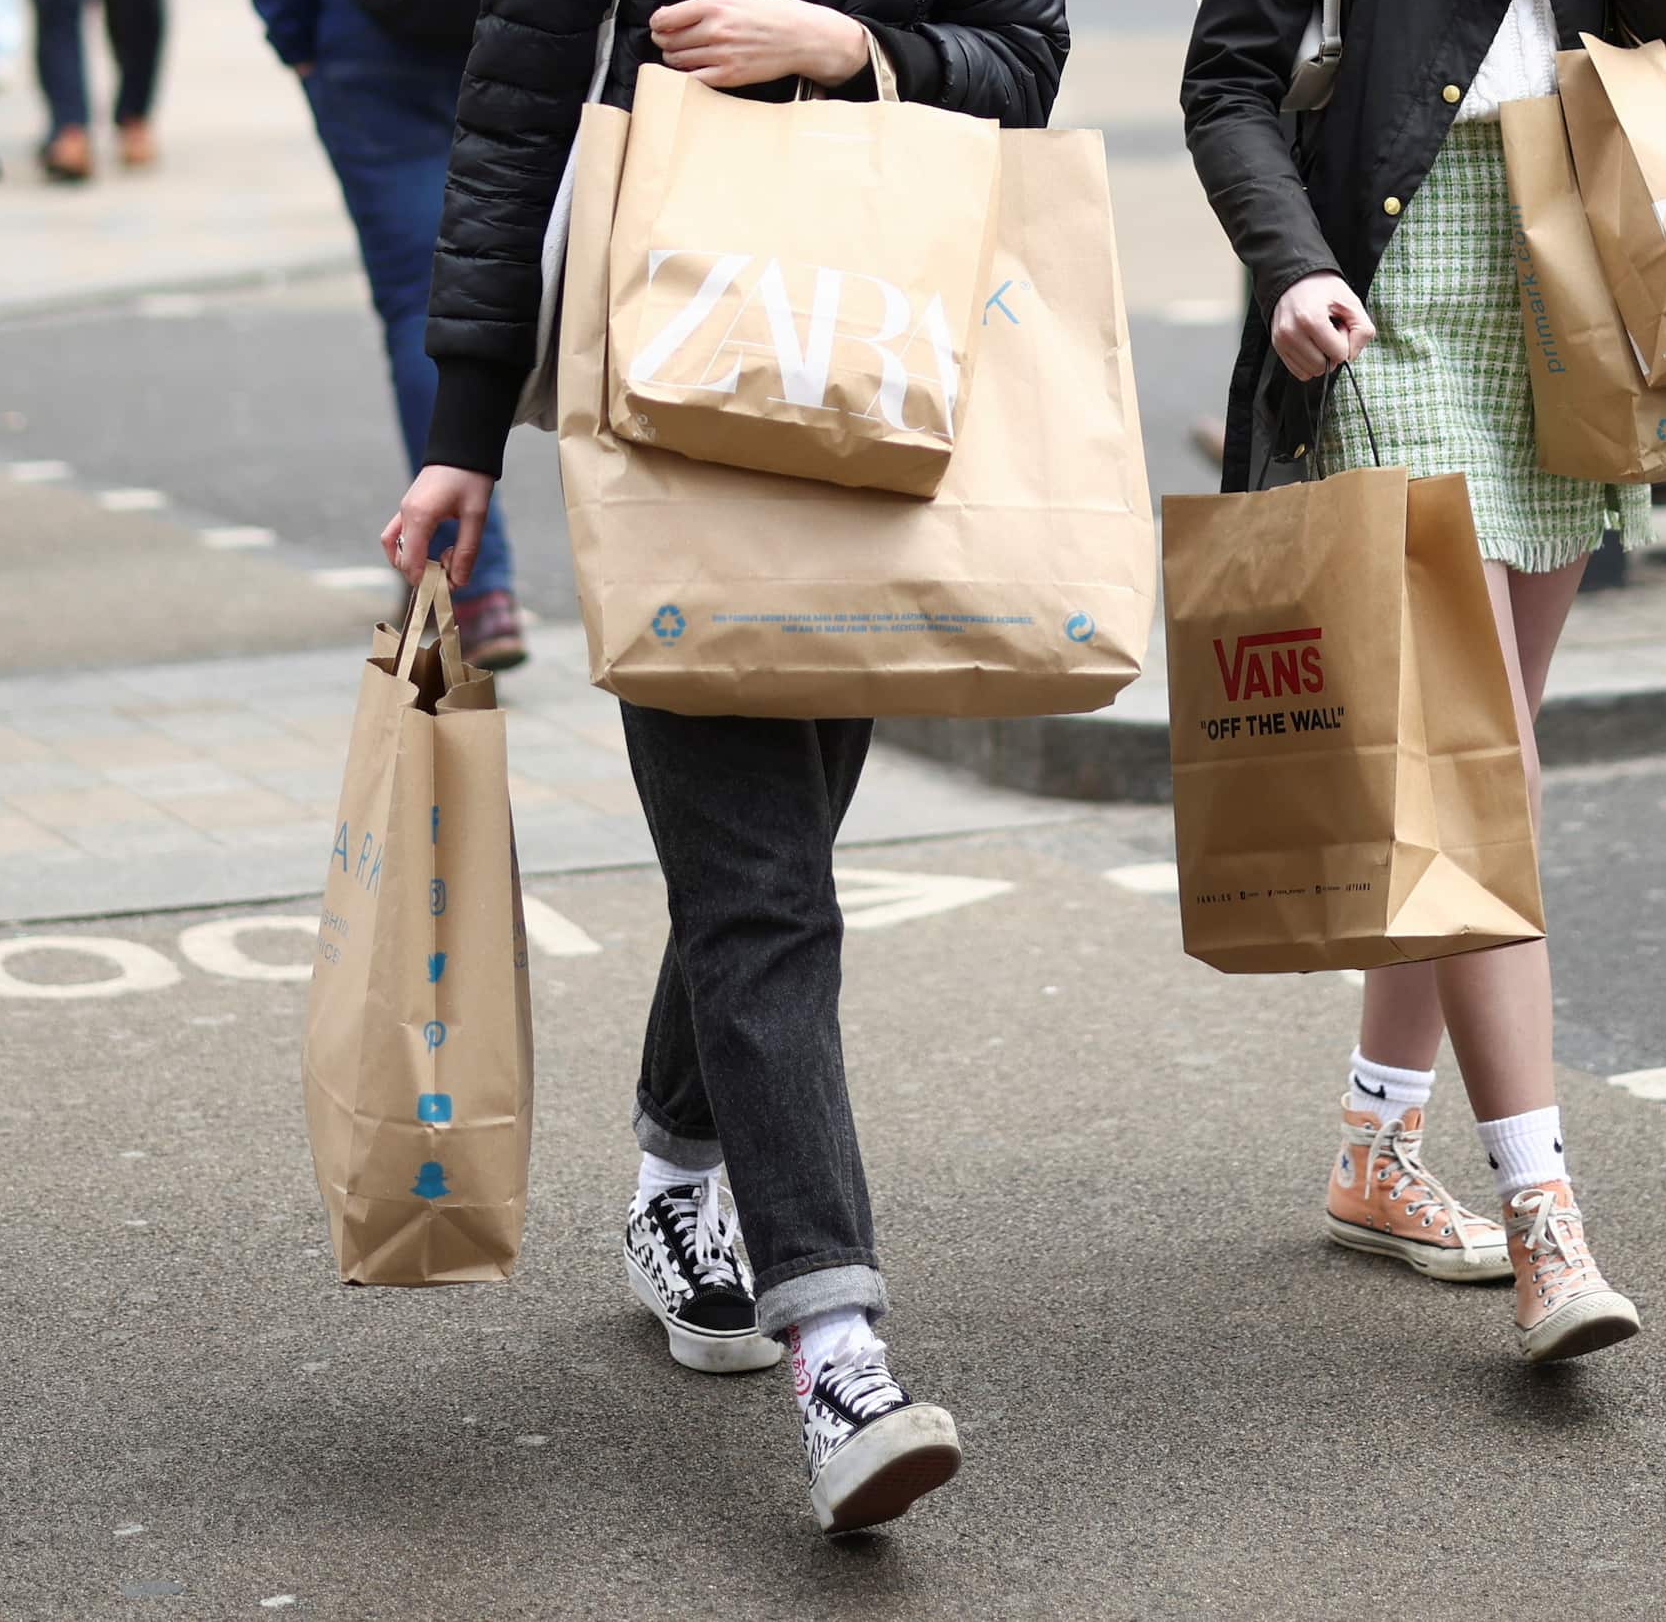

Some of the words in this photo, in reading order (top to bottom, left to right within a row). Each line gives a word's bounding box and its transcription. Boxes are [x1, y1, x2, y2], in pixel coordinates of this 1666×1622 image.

[628, 248, 959, 439] ZARA
[1510, 204, 1566, 375] primark.com
[1200, 716, 1242, 742] "OFF
[1245, 712, 1287, 737] THE
[1289, 706, 1345, 733] WALL"
[1212, 627, 1324, 702] VANS
